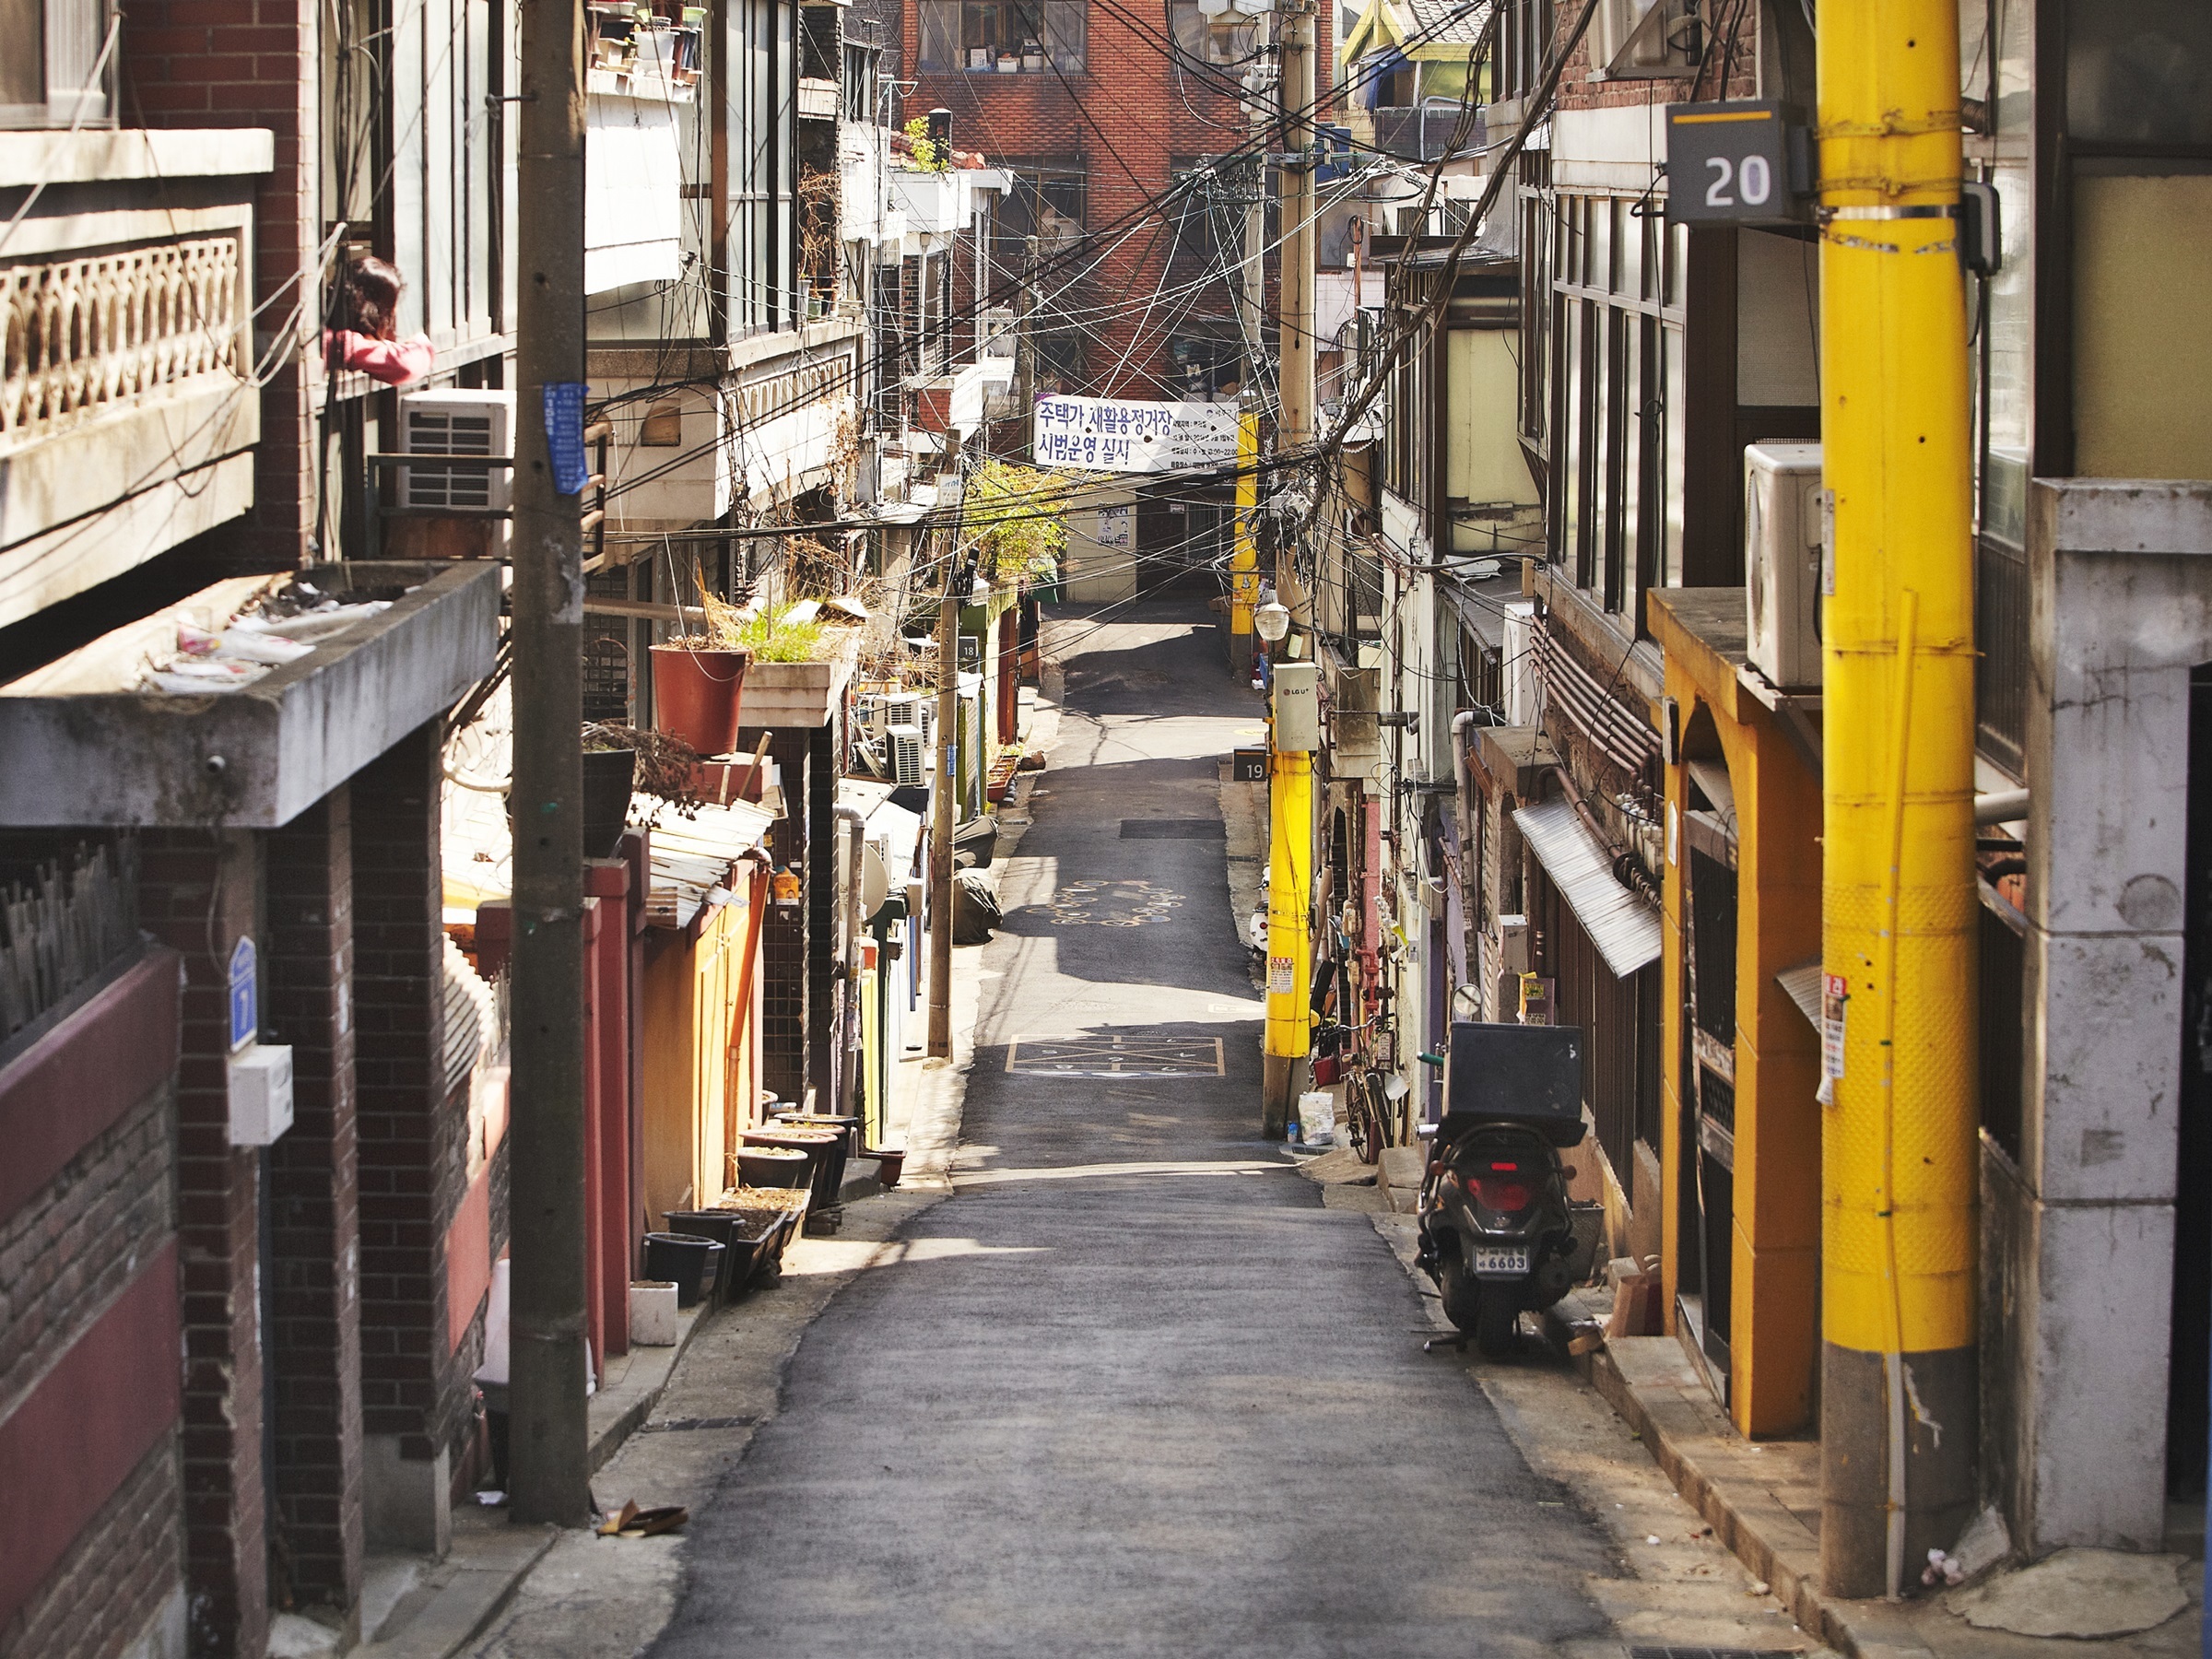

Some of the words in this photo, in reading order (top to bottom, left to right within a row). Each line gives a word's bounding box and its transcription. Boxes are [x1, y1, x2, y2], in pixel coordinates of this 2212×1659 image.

[1705, 155, 1771, 206] 20
[1040, 401, 1084, 429] 주택가
[1089, 406, 1172, 436] 재활용정거장
[1039, 433, 1097, 463] 시범운영
[1101, 439, 1130, 465] 실시
[964, 647, 973, 655] 18
[1246, 764, 1263, 779] 19
[1488, 1256, 1525, 1269] 6603
